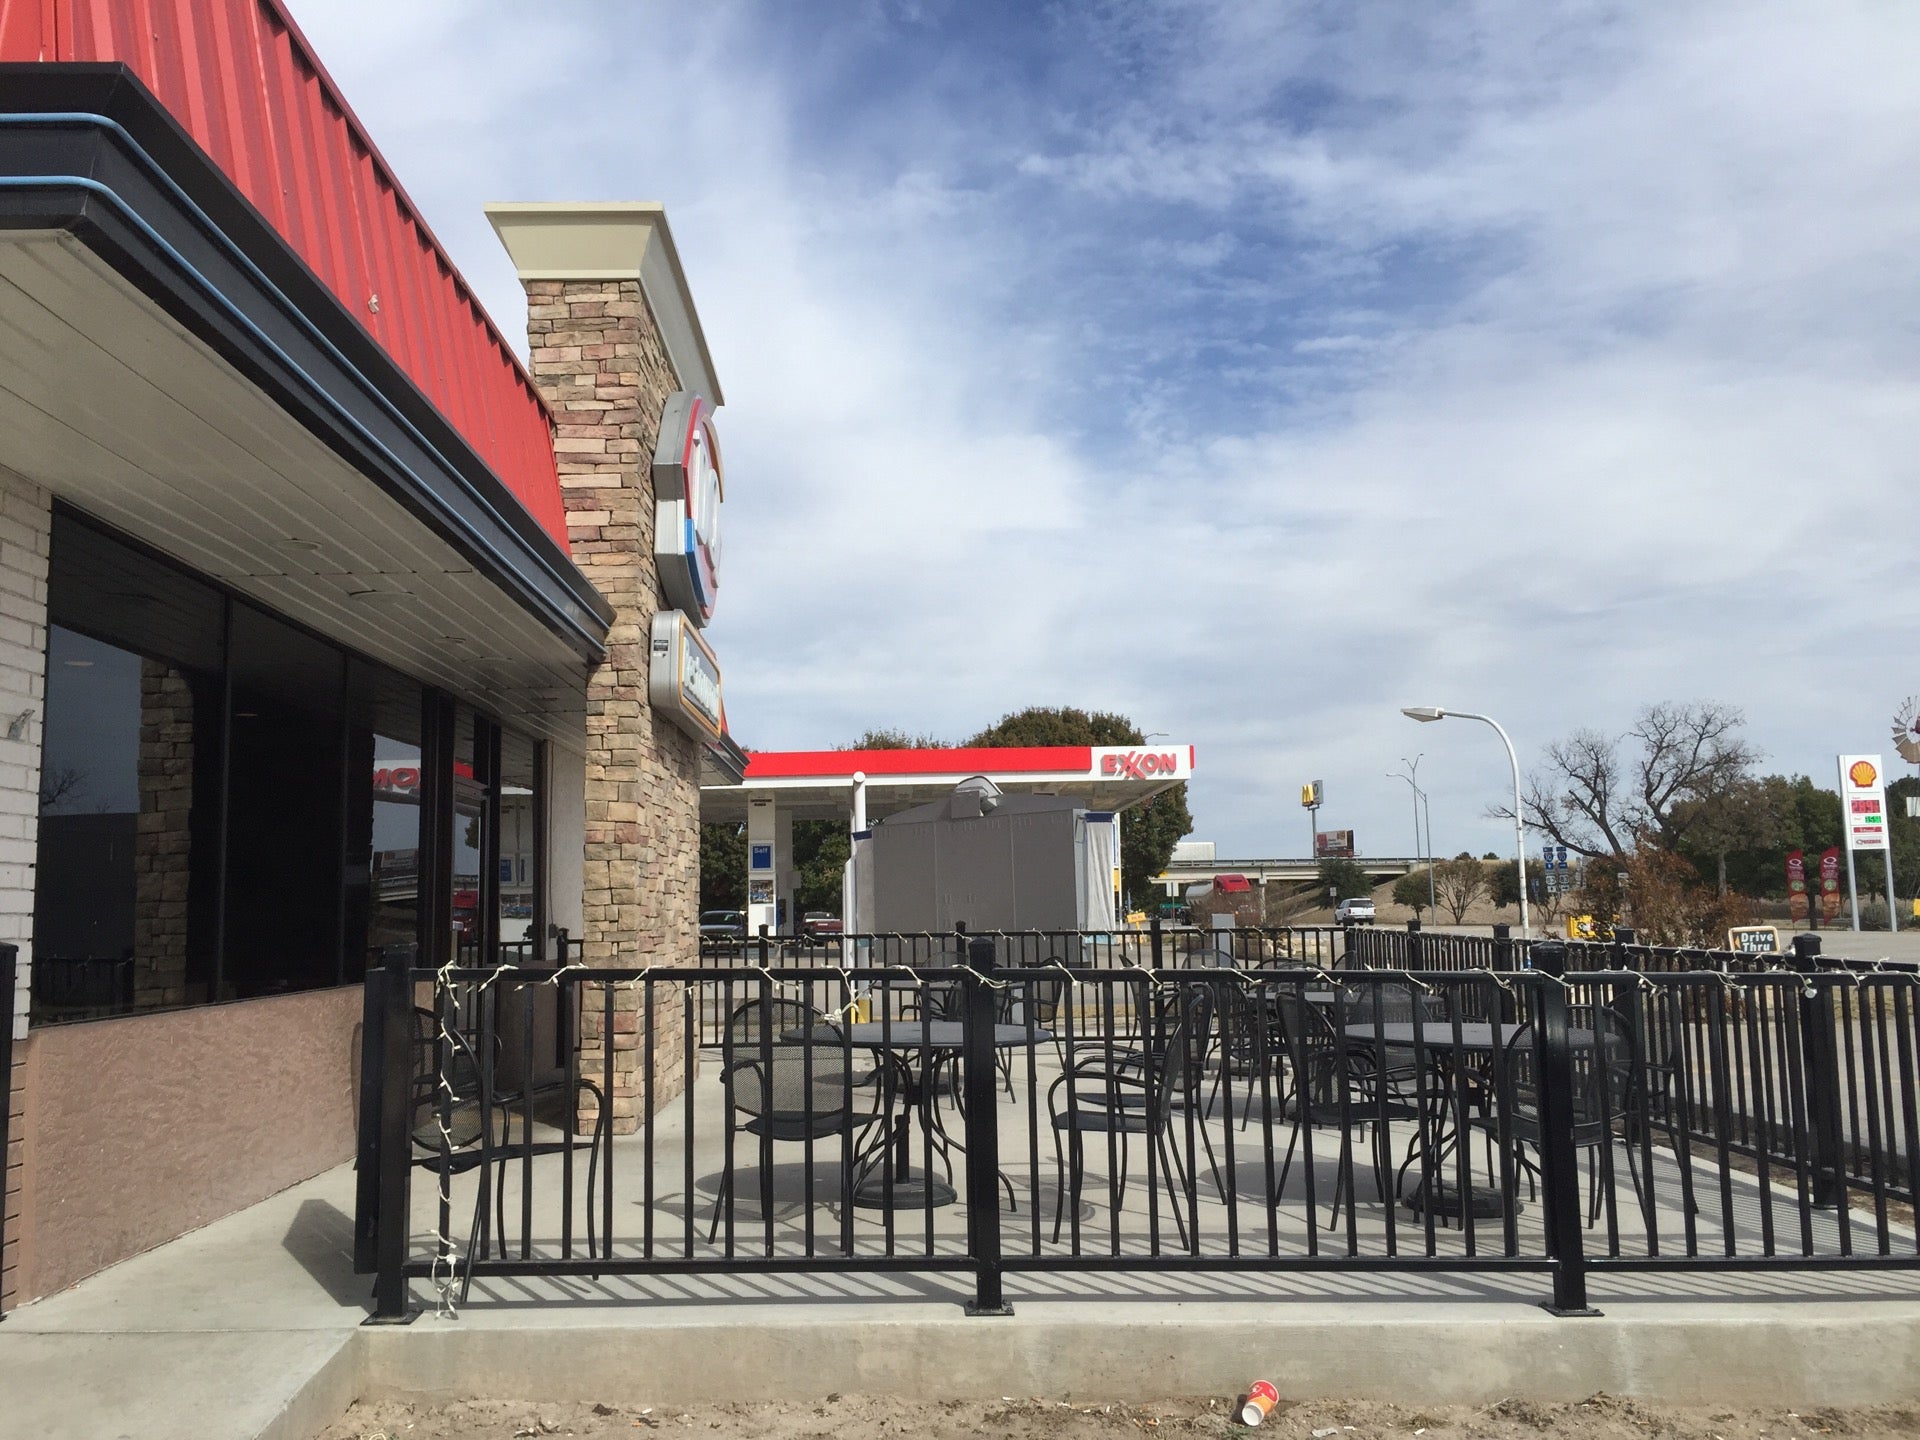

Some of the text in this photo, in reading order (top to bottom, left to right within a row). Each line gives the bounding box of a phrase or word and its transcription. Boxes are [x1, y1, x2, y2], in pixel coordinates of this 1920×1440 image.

[1102, 751, 1177, 780] EXXON
[1741, 931, 1774, 942] Drive
[1742, 942, 1770, 952] Thru
